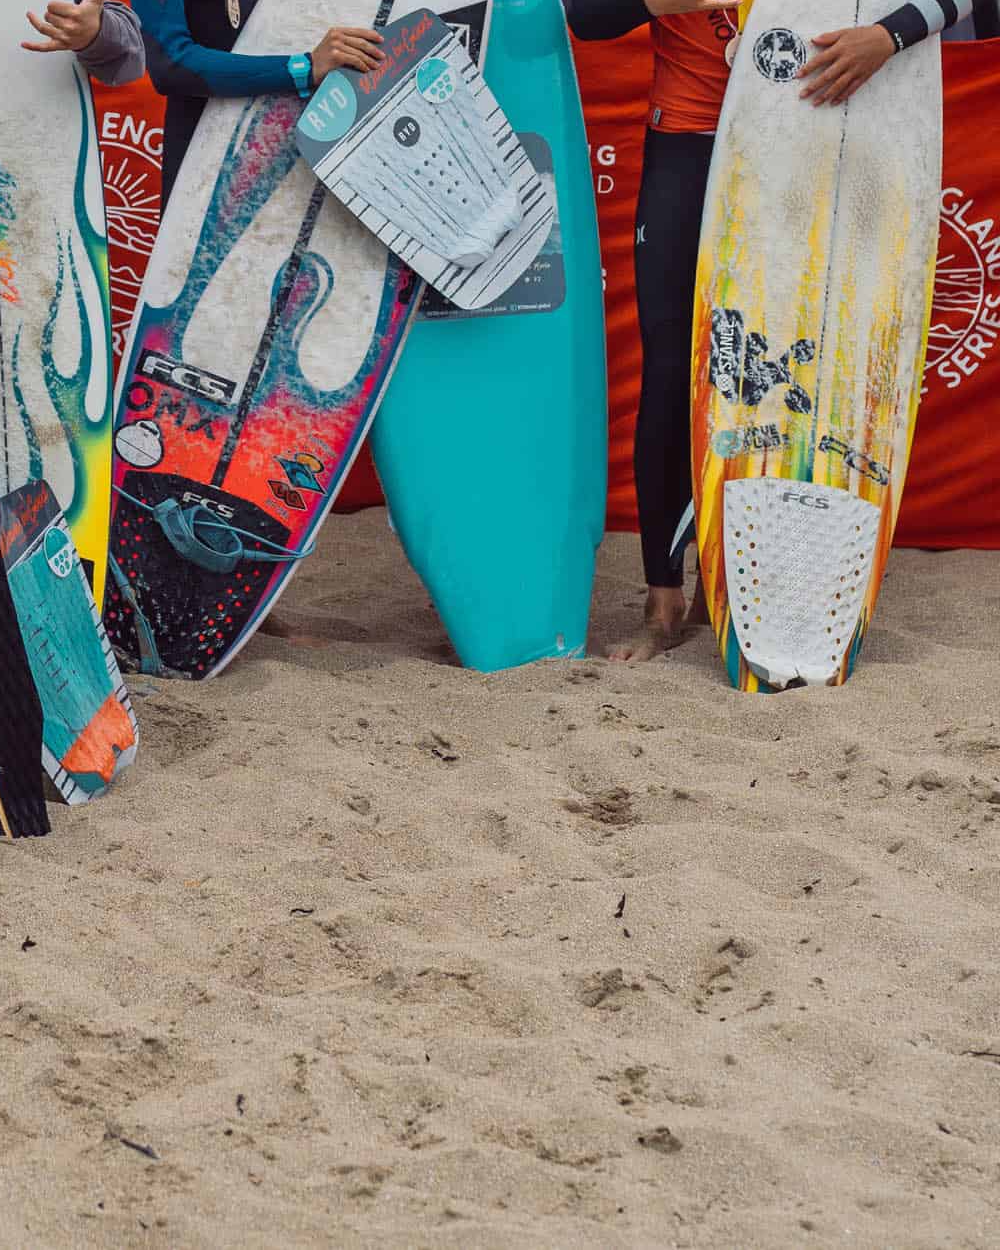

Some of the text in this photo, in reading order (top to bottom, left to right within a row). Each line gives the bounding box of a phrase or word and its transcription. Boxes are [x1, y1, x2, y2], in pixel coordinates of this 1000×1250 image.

[306, 86, 349, 133] RYD
[398, 121, 418, 143] RYD
[719, 316, 736, 373] STANCE
[142, 355, 228, 400] FCS
[182, 491, 236, 520] FCS
[782, 492, 831, 510] FCS
